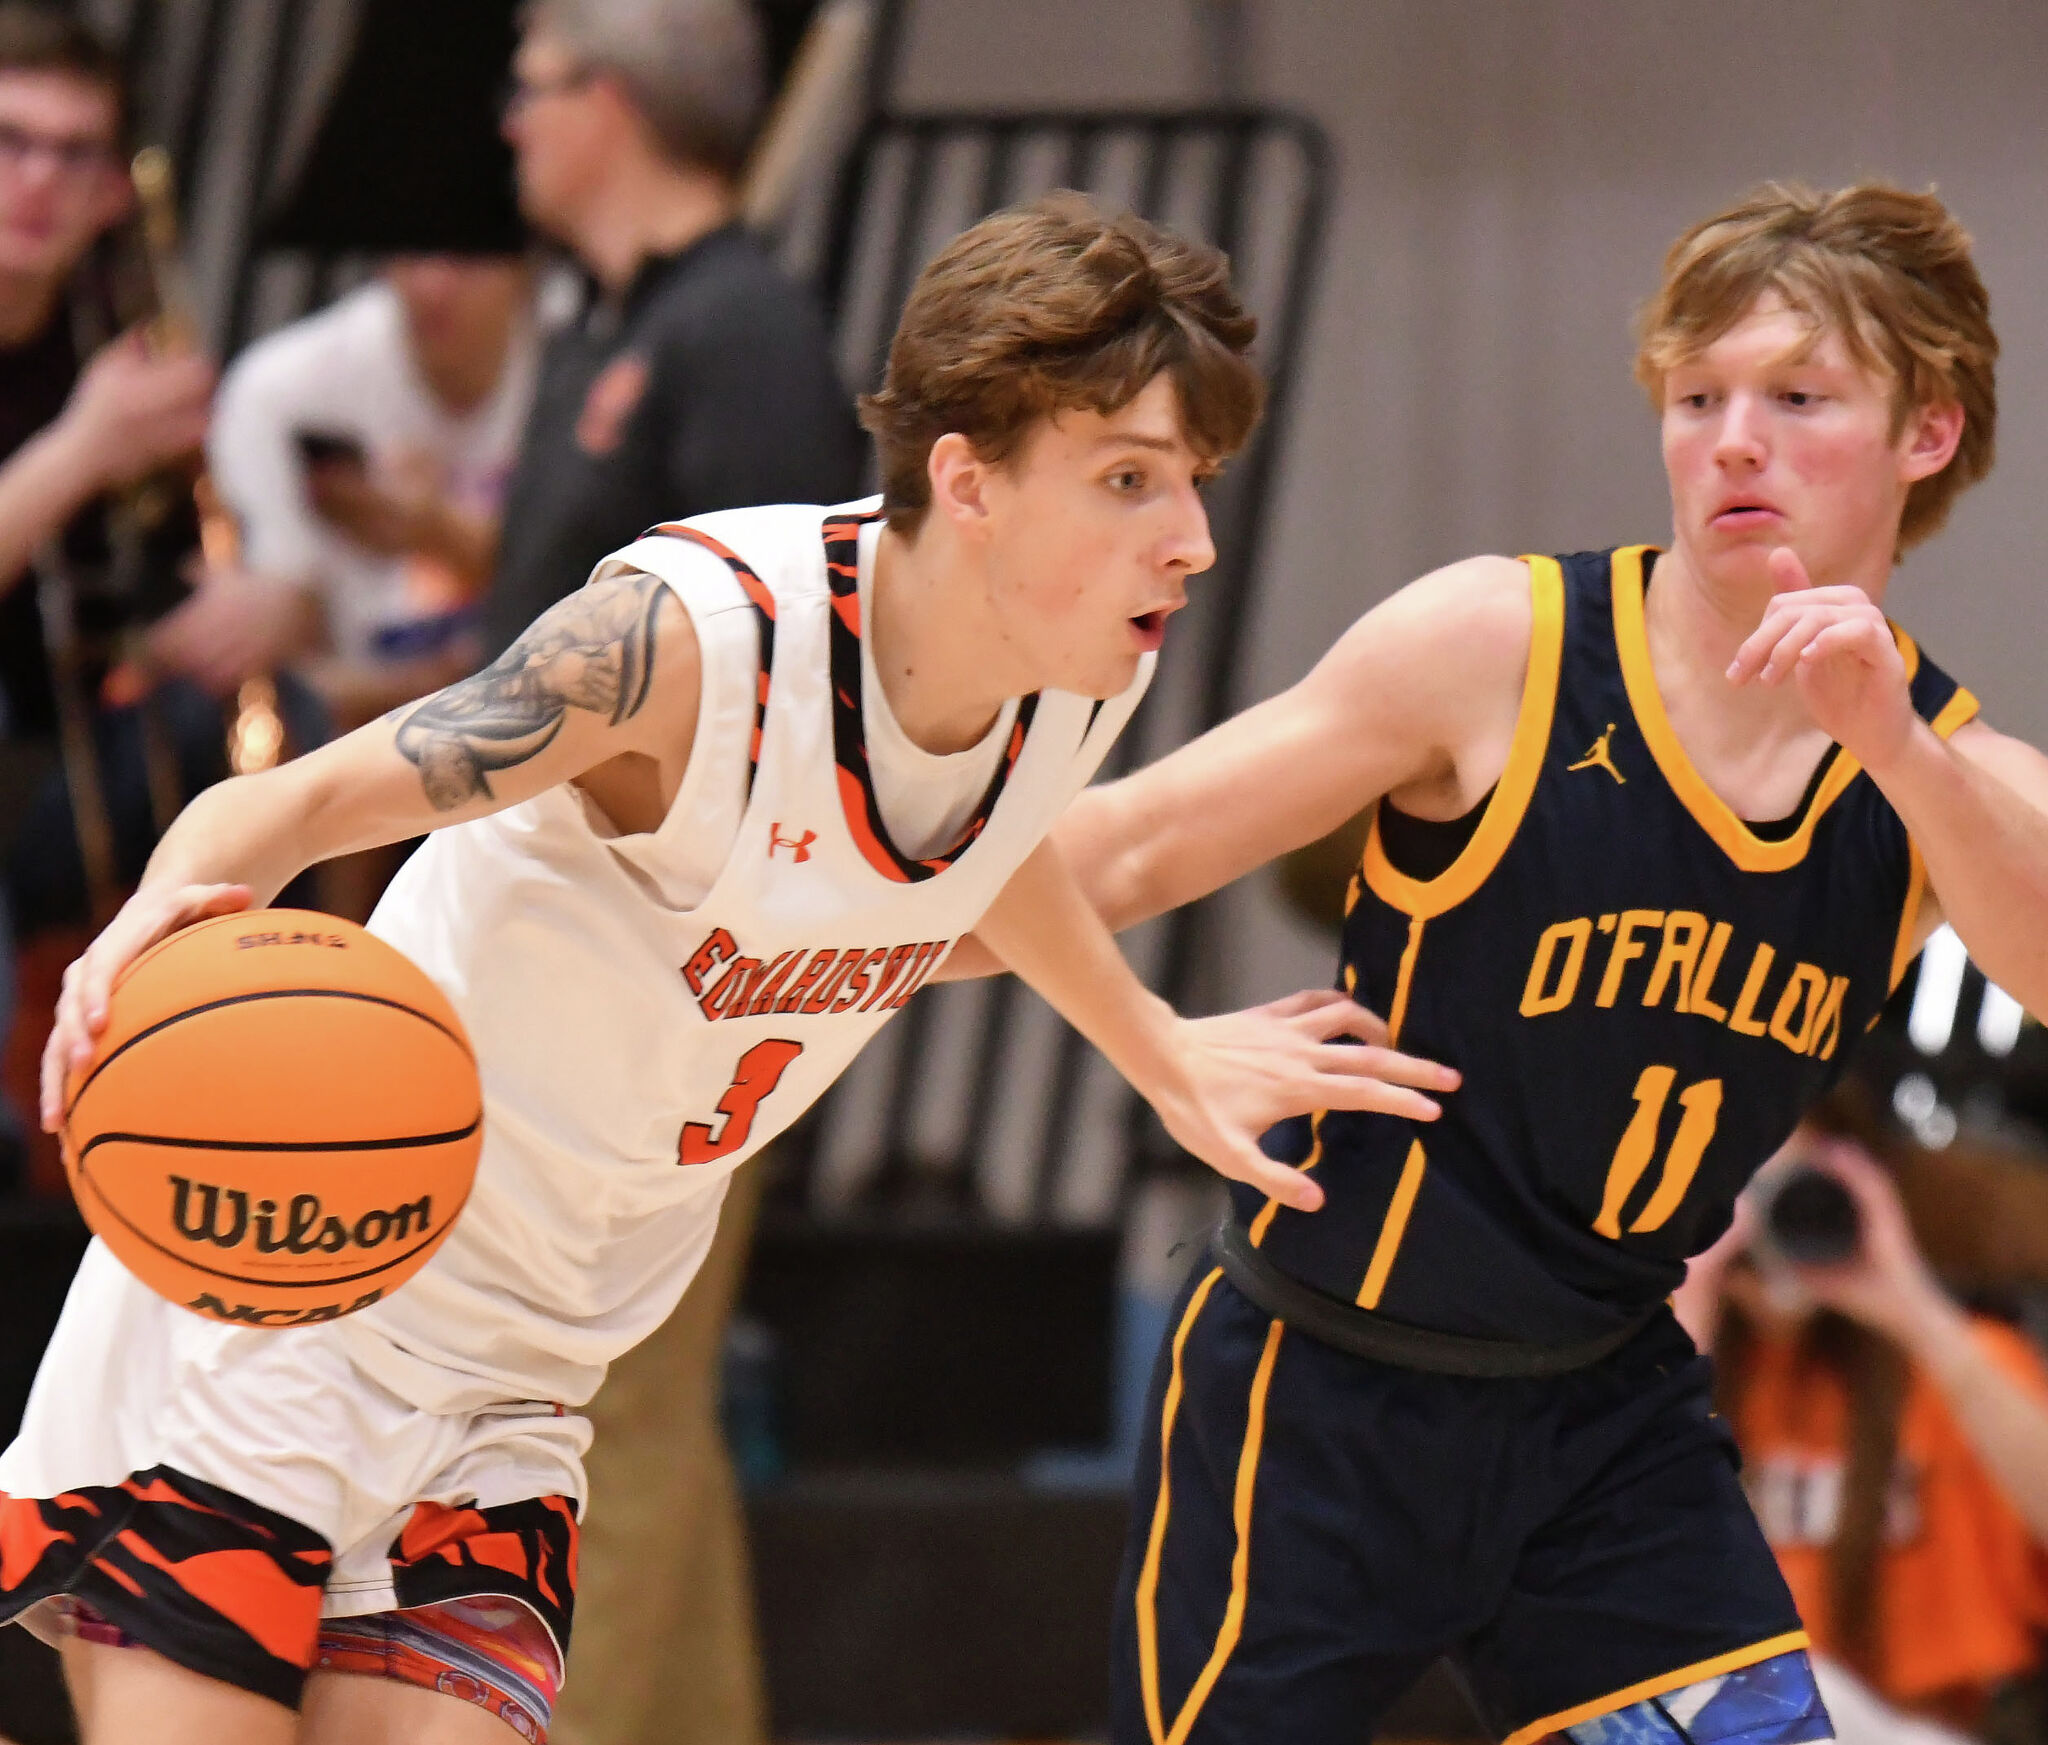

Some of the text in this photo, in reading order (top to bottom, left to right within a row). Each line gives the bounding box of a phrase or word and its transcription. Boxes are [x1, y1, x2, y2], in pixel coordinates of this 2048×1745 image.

[676, 1038, 804, 1166] 3
[1591, 1064, 1724, 1241] 11
[167, 1175, 433, 1255] Wilson
